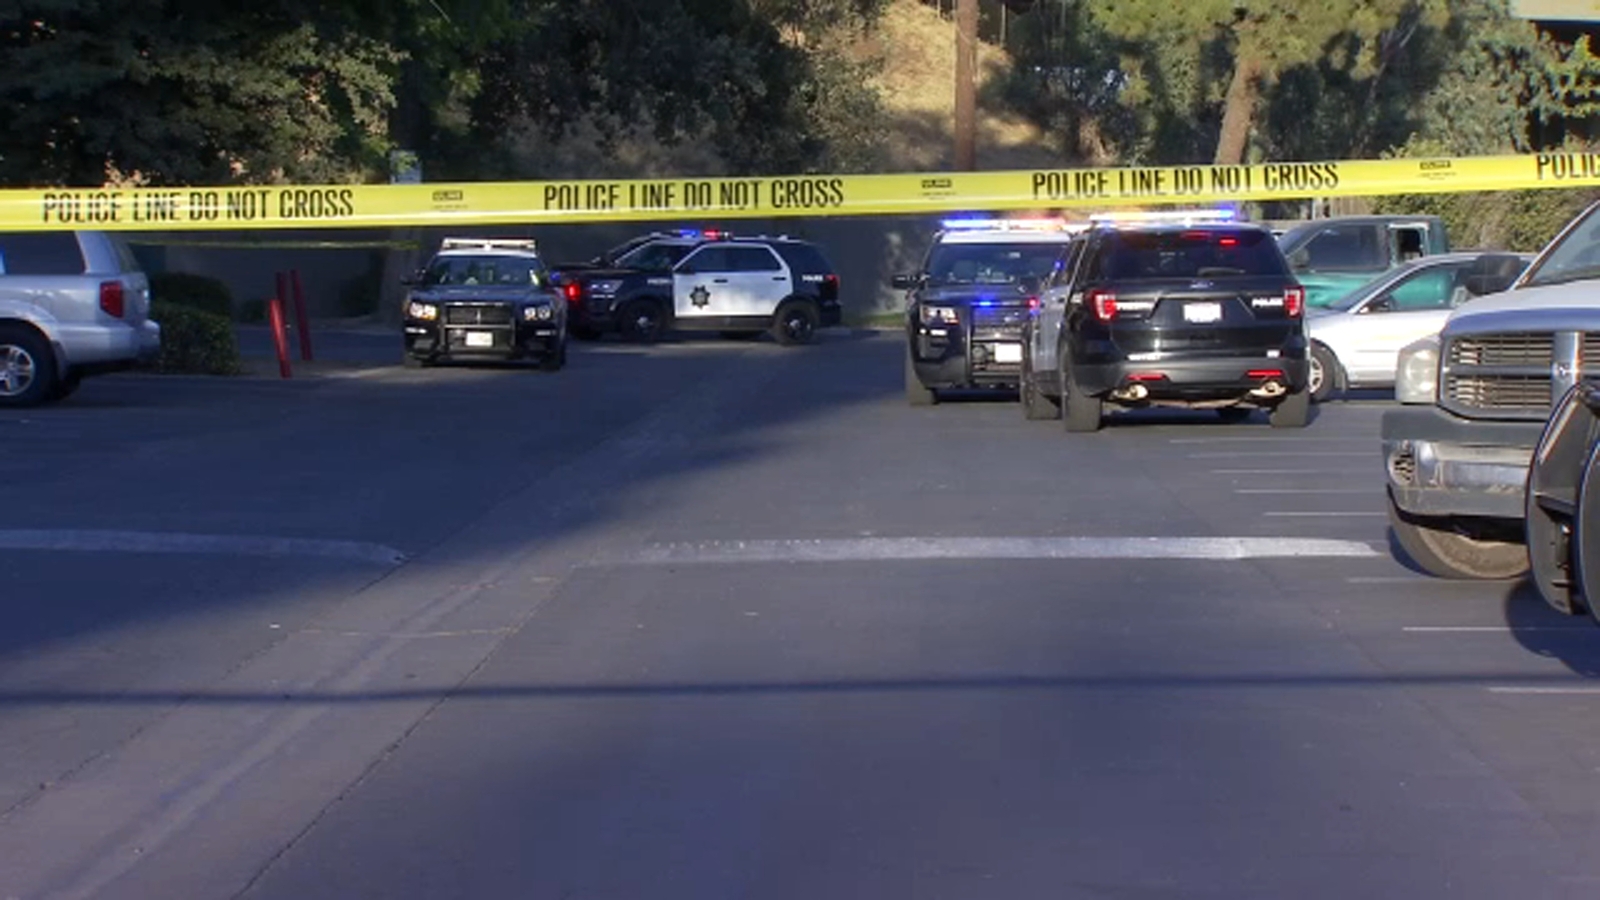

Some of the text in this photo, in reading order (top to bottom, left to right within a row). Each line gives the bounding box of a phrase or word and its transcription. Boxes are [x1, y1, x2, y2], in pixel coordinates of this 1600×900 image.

[544, 178, 843, 211] POLICE LINE DO NOT CROSS
[1033, 162, 1338, 200] POLICE LINE DO NOT CROSS
[43, 189, 353, 223] POLICE LINE DO NOT CROSS
